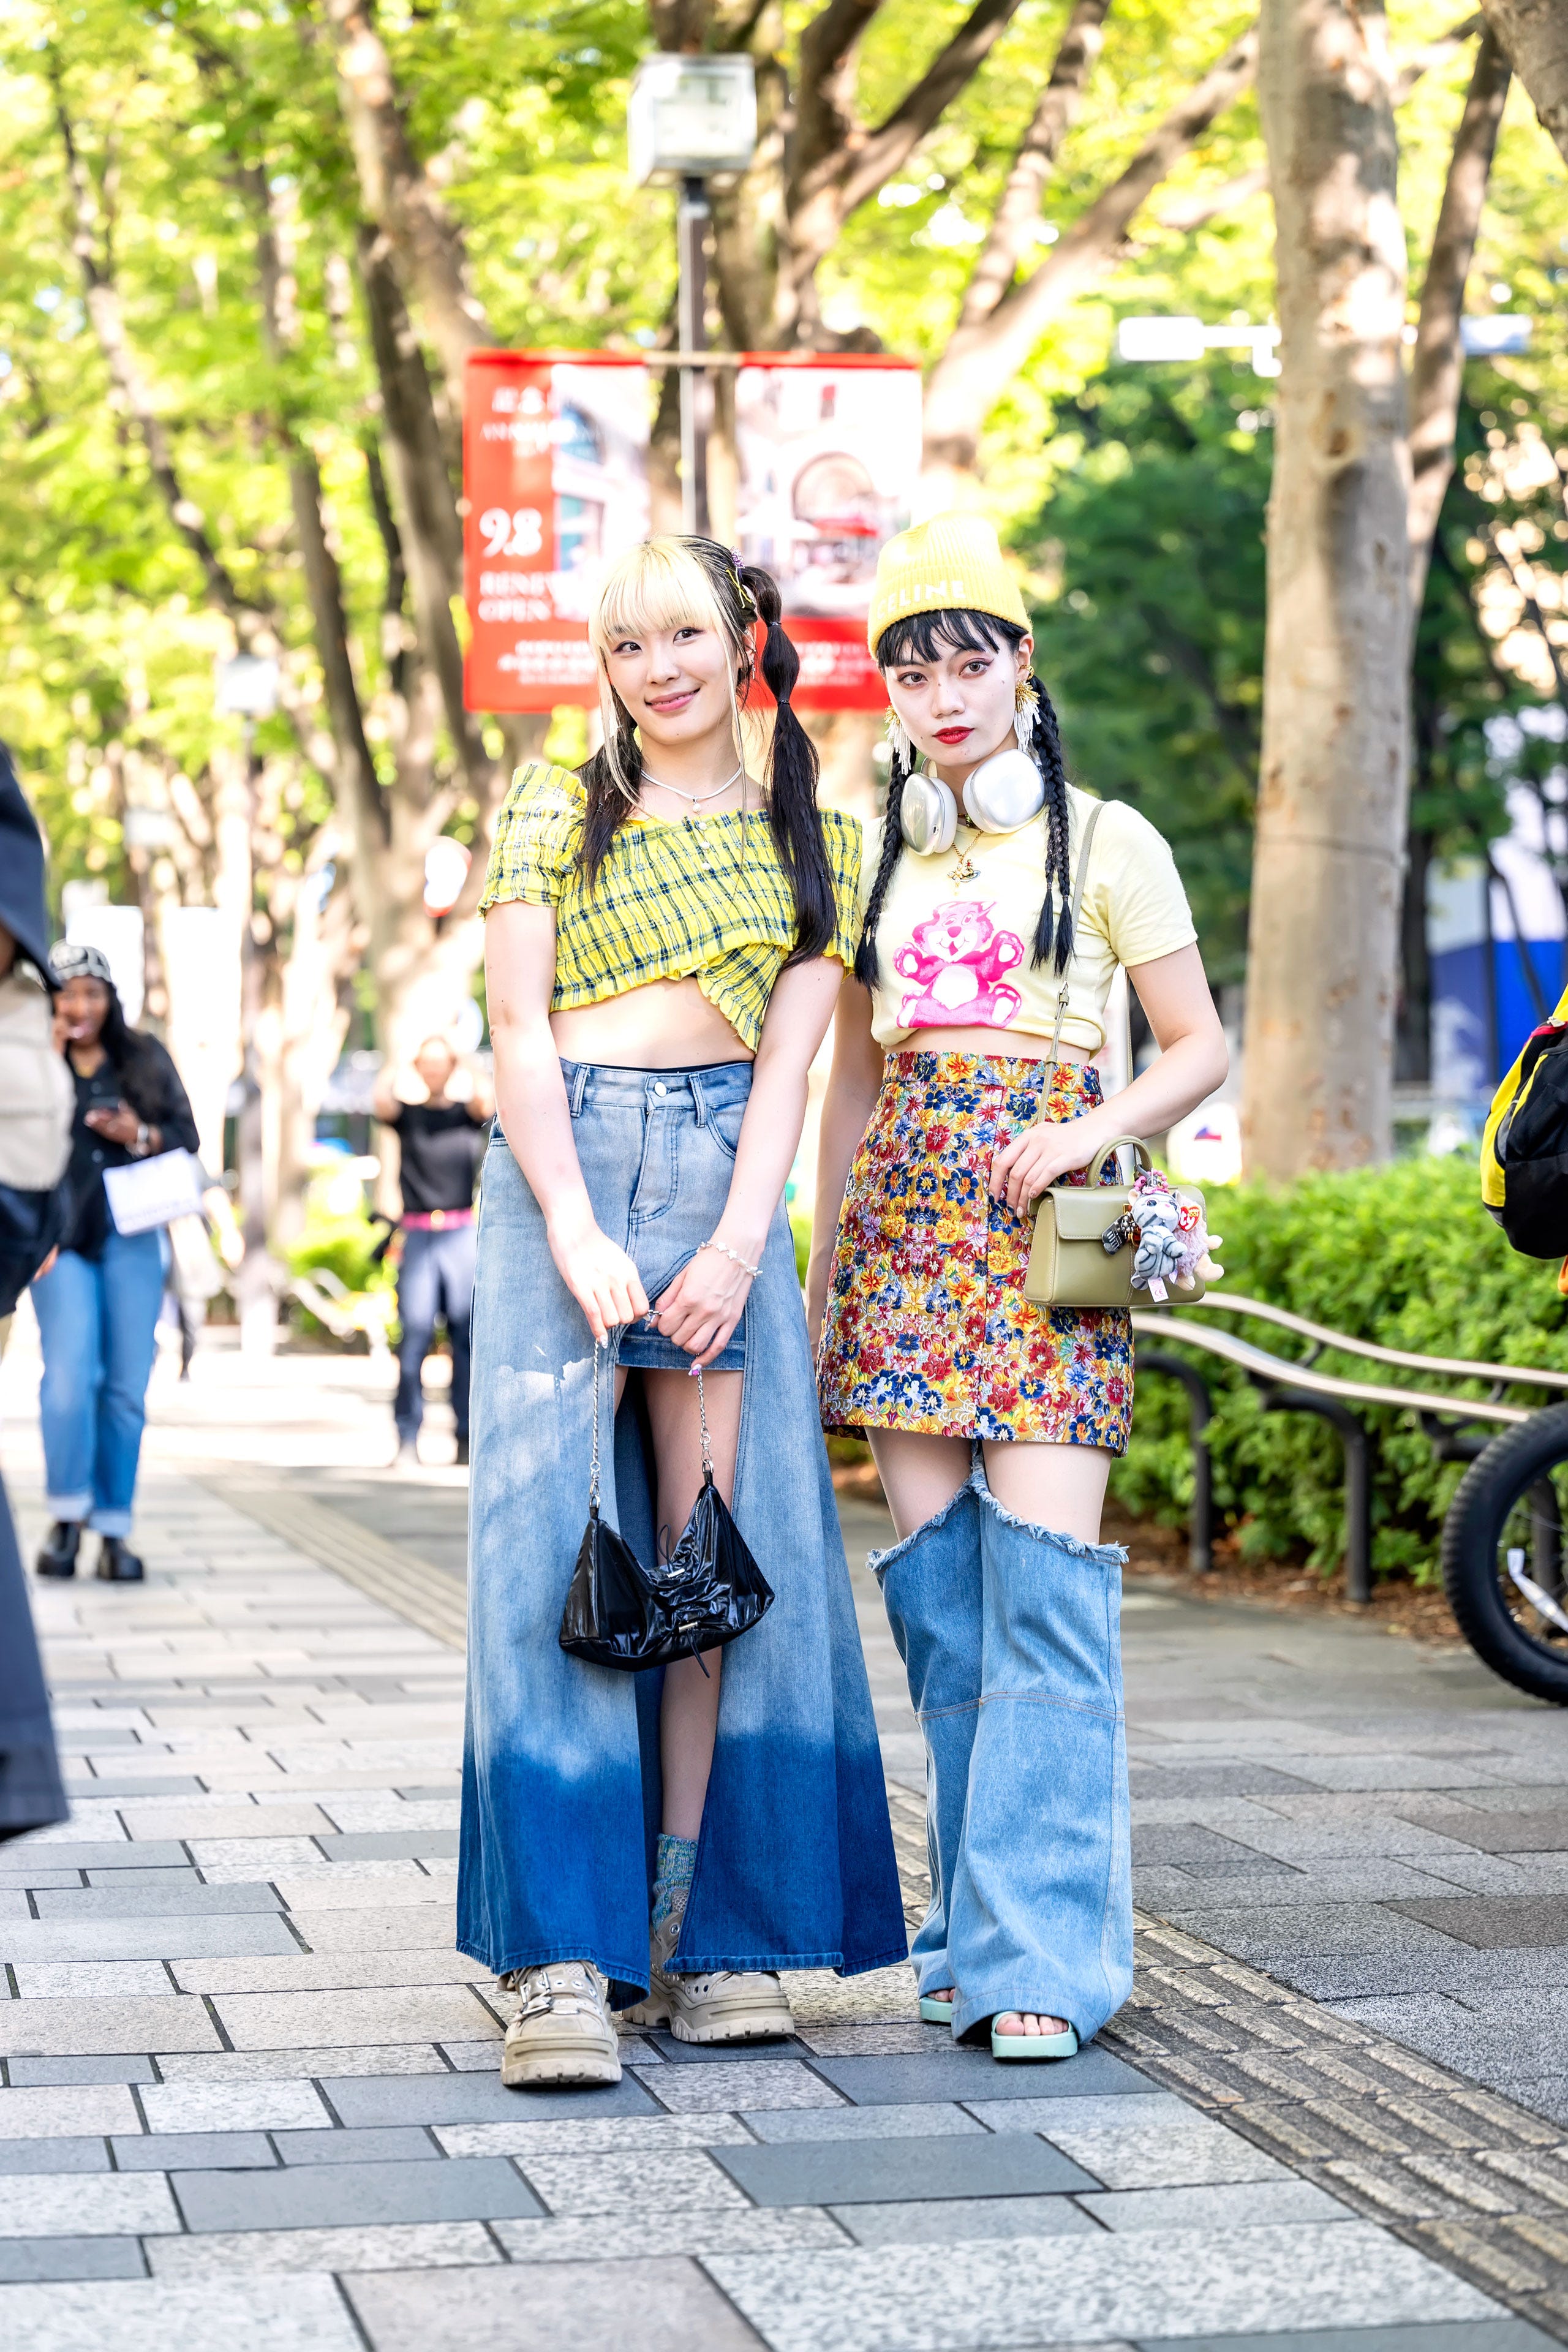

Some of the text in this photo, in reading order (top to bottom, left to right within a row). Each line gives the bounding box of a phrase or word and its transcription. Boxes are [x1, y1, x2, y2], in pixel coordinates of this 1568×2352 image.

[479, 508, 543, 558] 9.8
[478, 597, 551, 622] OPEN
[876, 579, 967, 619] CELINE
[1180, 1210, 1196, 1231] ty
